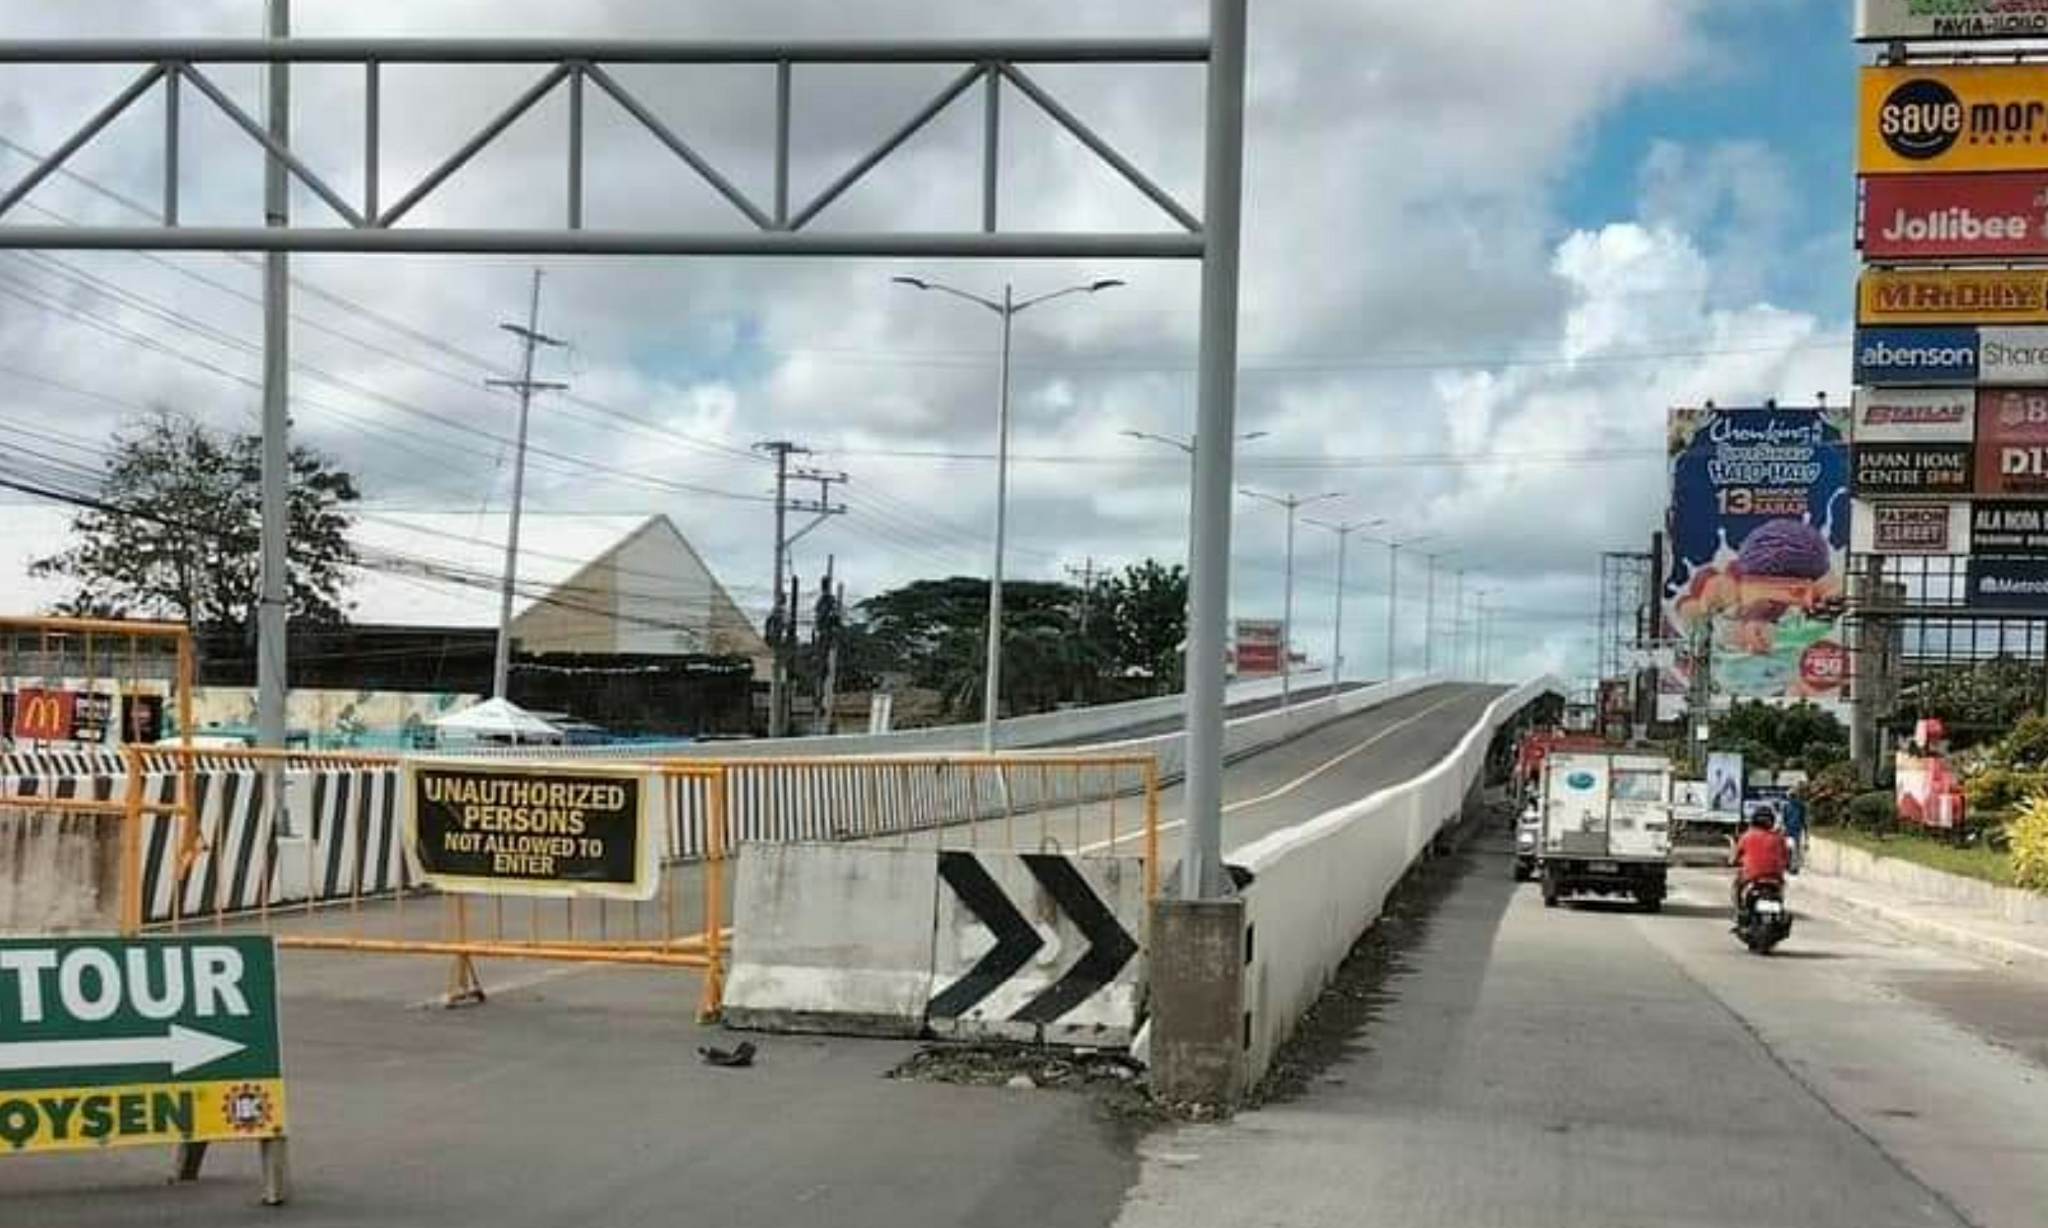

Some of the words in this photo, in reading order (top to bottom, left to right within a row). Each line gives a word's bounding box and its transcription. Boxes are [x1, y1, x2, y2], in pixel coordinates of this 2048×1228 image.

[1882, 103, 1961, 135] save
[1883, 207, 2028, 241] Jollibee
[1861, 340, 1974, 367] abenson
[1857, 452, 1910, 468] JAPAN
[1858, 470, 1920, 485] CENTRE
[1715, 488, 1752, 514] 13
[424, 777, 625, 811] UNAUTHORIZED
[463, 805, 585, 835] PERSONS
[444, 832, 482, 852] NOT
[482, 834, 576, 857] ALLOWED
[579, 839, 603, 858] TO
[493, 854, 554, 875] ENTER
[1, 945, 250, 1024] TOUR
